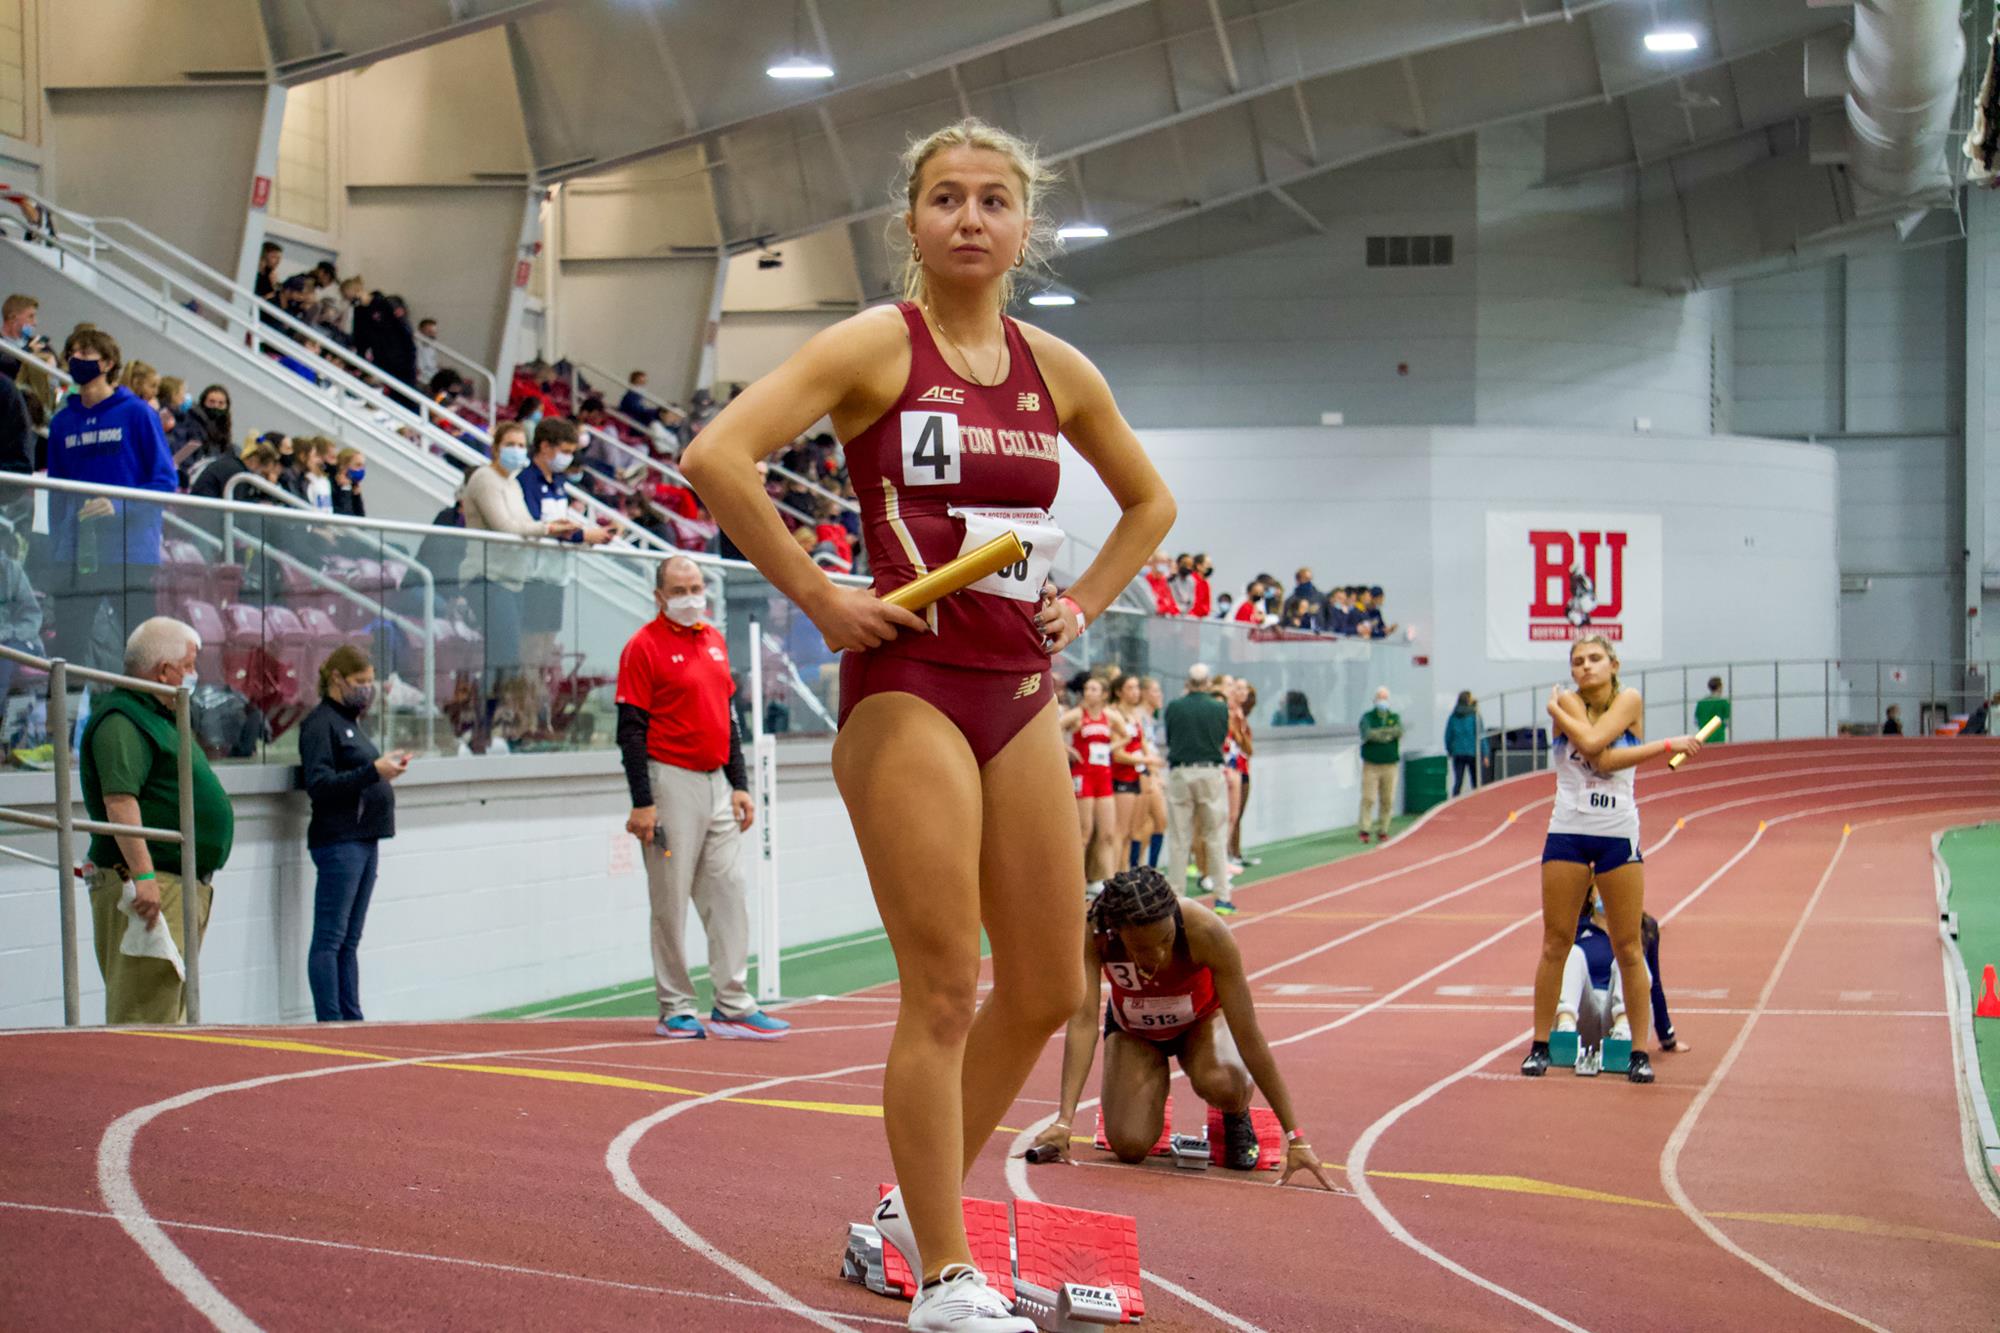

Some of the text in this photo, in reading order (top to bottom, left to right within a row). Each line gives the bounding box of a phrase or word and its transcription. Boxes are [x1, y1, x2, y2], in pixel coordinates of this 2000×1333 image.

[919, 386, 965, 403] ACC
[912, 415, 951, 480] 4
[1529, 531, 1627, 618] BU
[1590, 792, 1616, 809] 601
[1113, 964, 1134, 988] 3
[1141, 1014, 1179, 1027] 513
[1071, 1287, 1114, 1301] GILL
